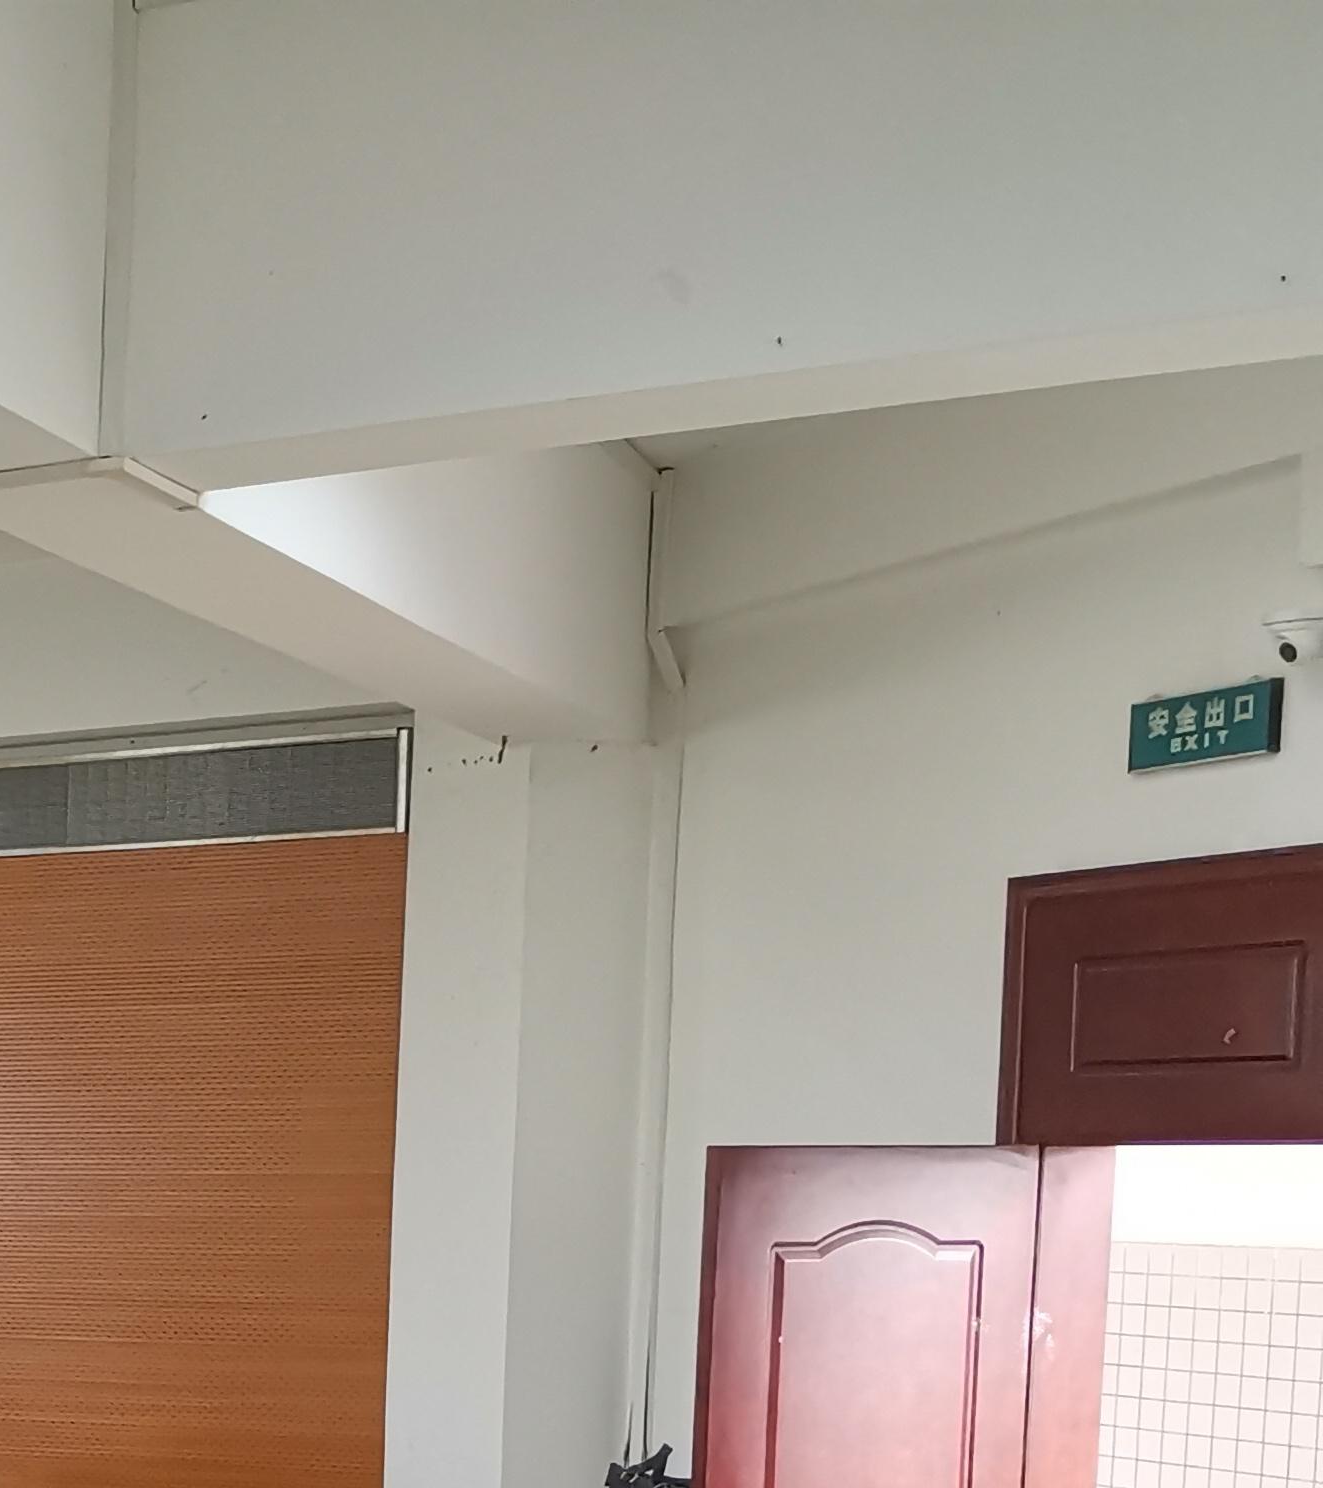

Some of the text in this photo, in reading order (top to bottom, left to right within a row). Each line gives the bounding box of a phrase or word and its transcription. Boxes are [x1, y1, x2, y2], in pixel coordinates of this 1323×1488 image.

[1147, 694, 1254, 738] 安全出口
[1170, 729, 1229, 752] EXIT
